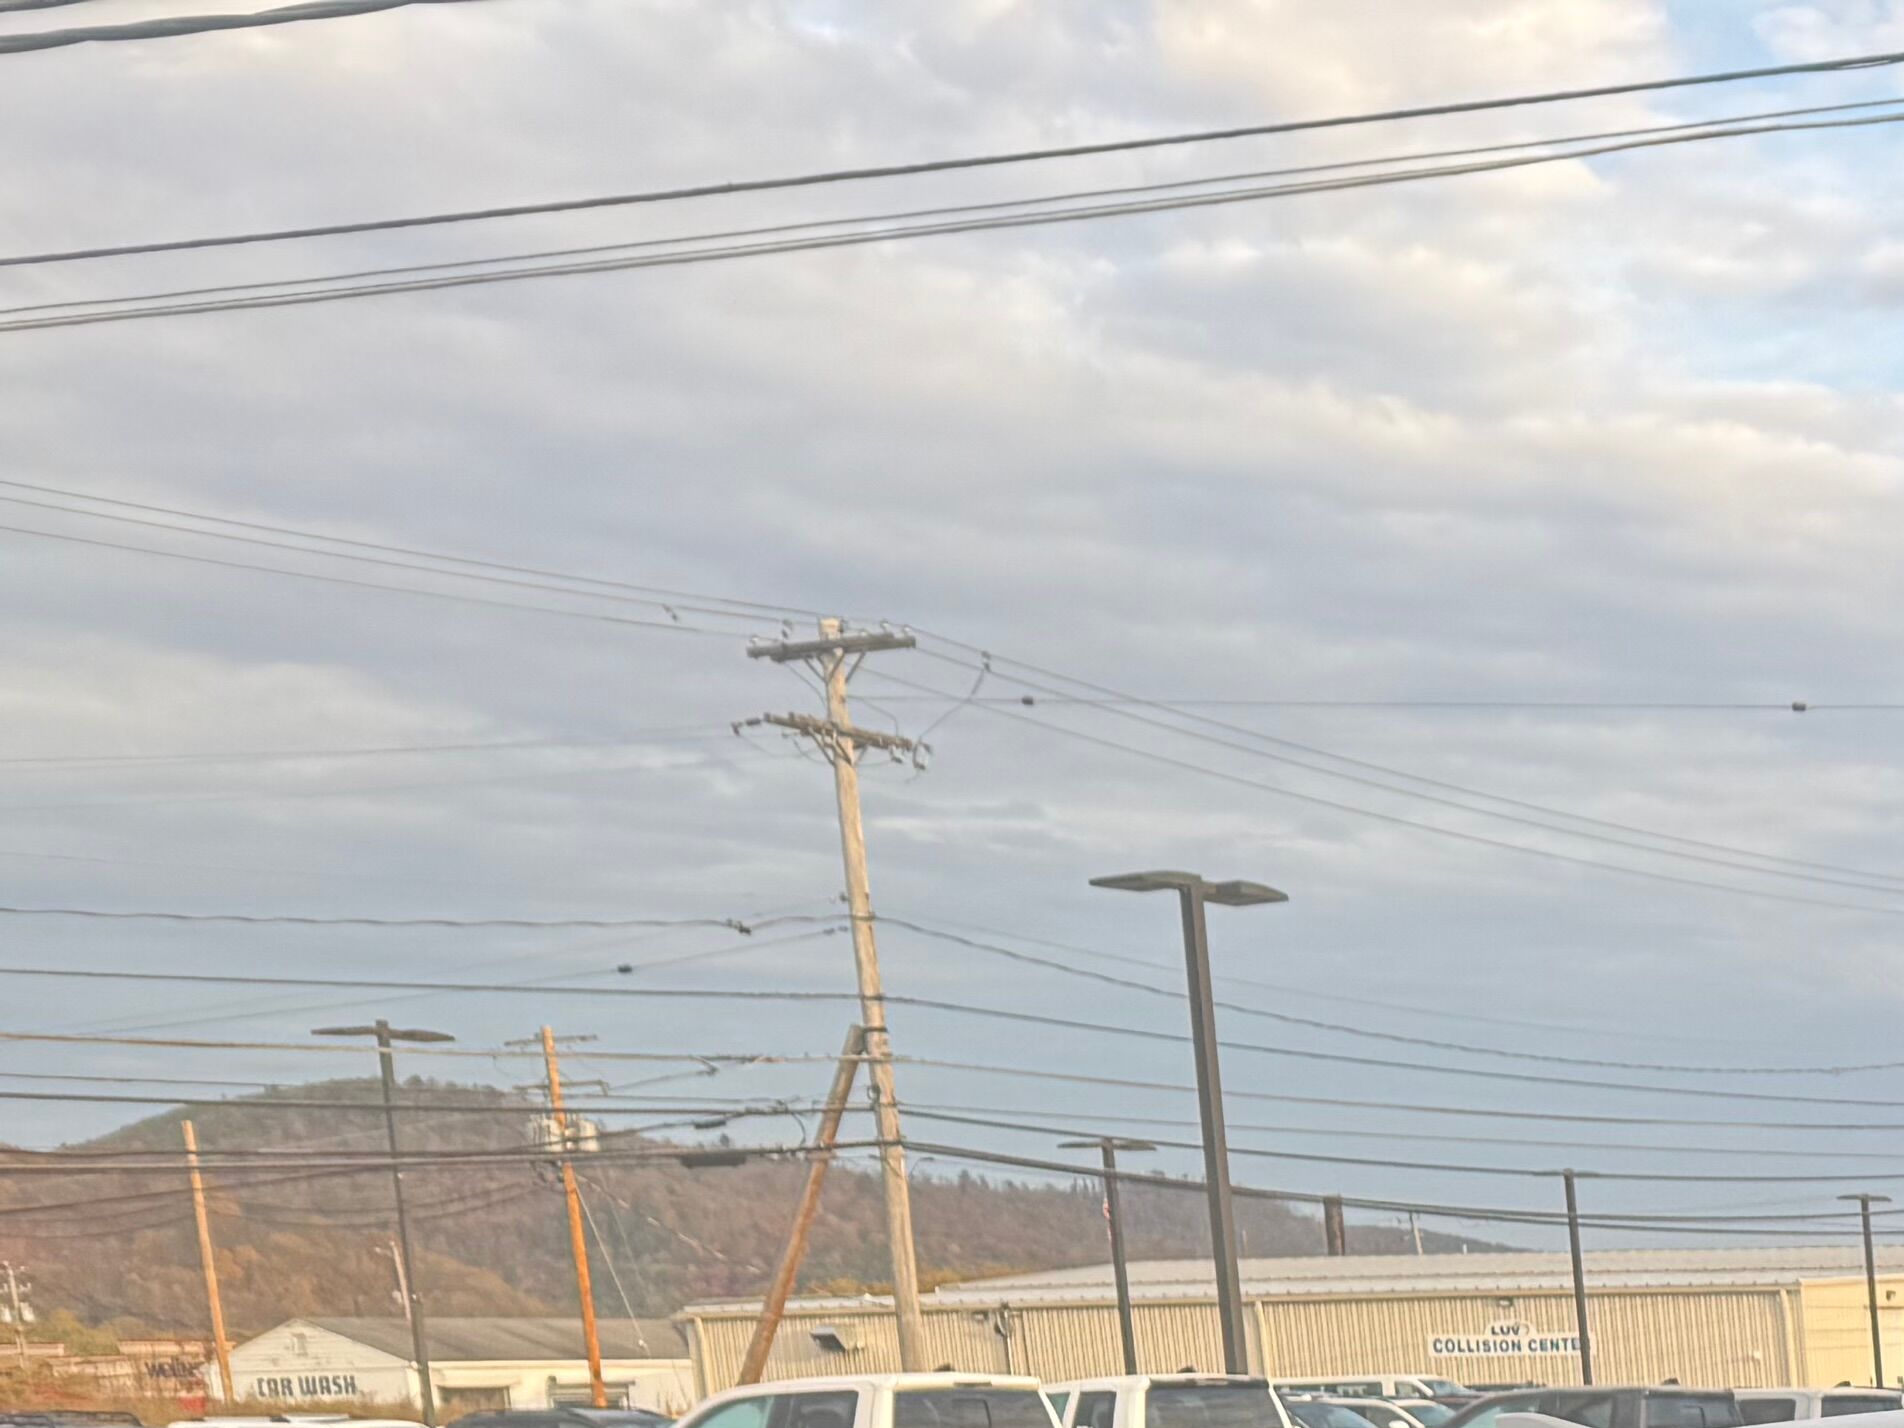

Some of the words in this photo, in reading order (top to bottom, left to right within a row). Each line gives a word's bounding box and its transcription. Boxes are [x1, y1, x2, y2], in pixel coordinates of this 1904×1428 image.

[1491, 1325, 1520, 1336] LUV
[1433, 1338, 1522, 1353] COLLISION
[1528, 1337, 1581, 1352] CENTE
[256, 1376, 295, 1398] CAR
[298, 1375, 358, 1397] WASH
